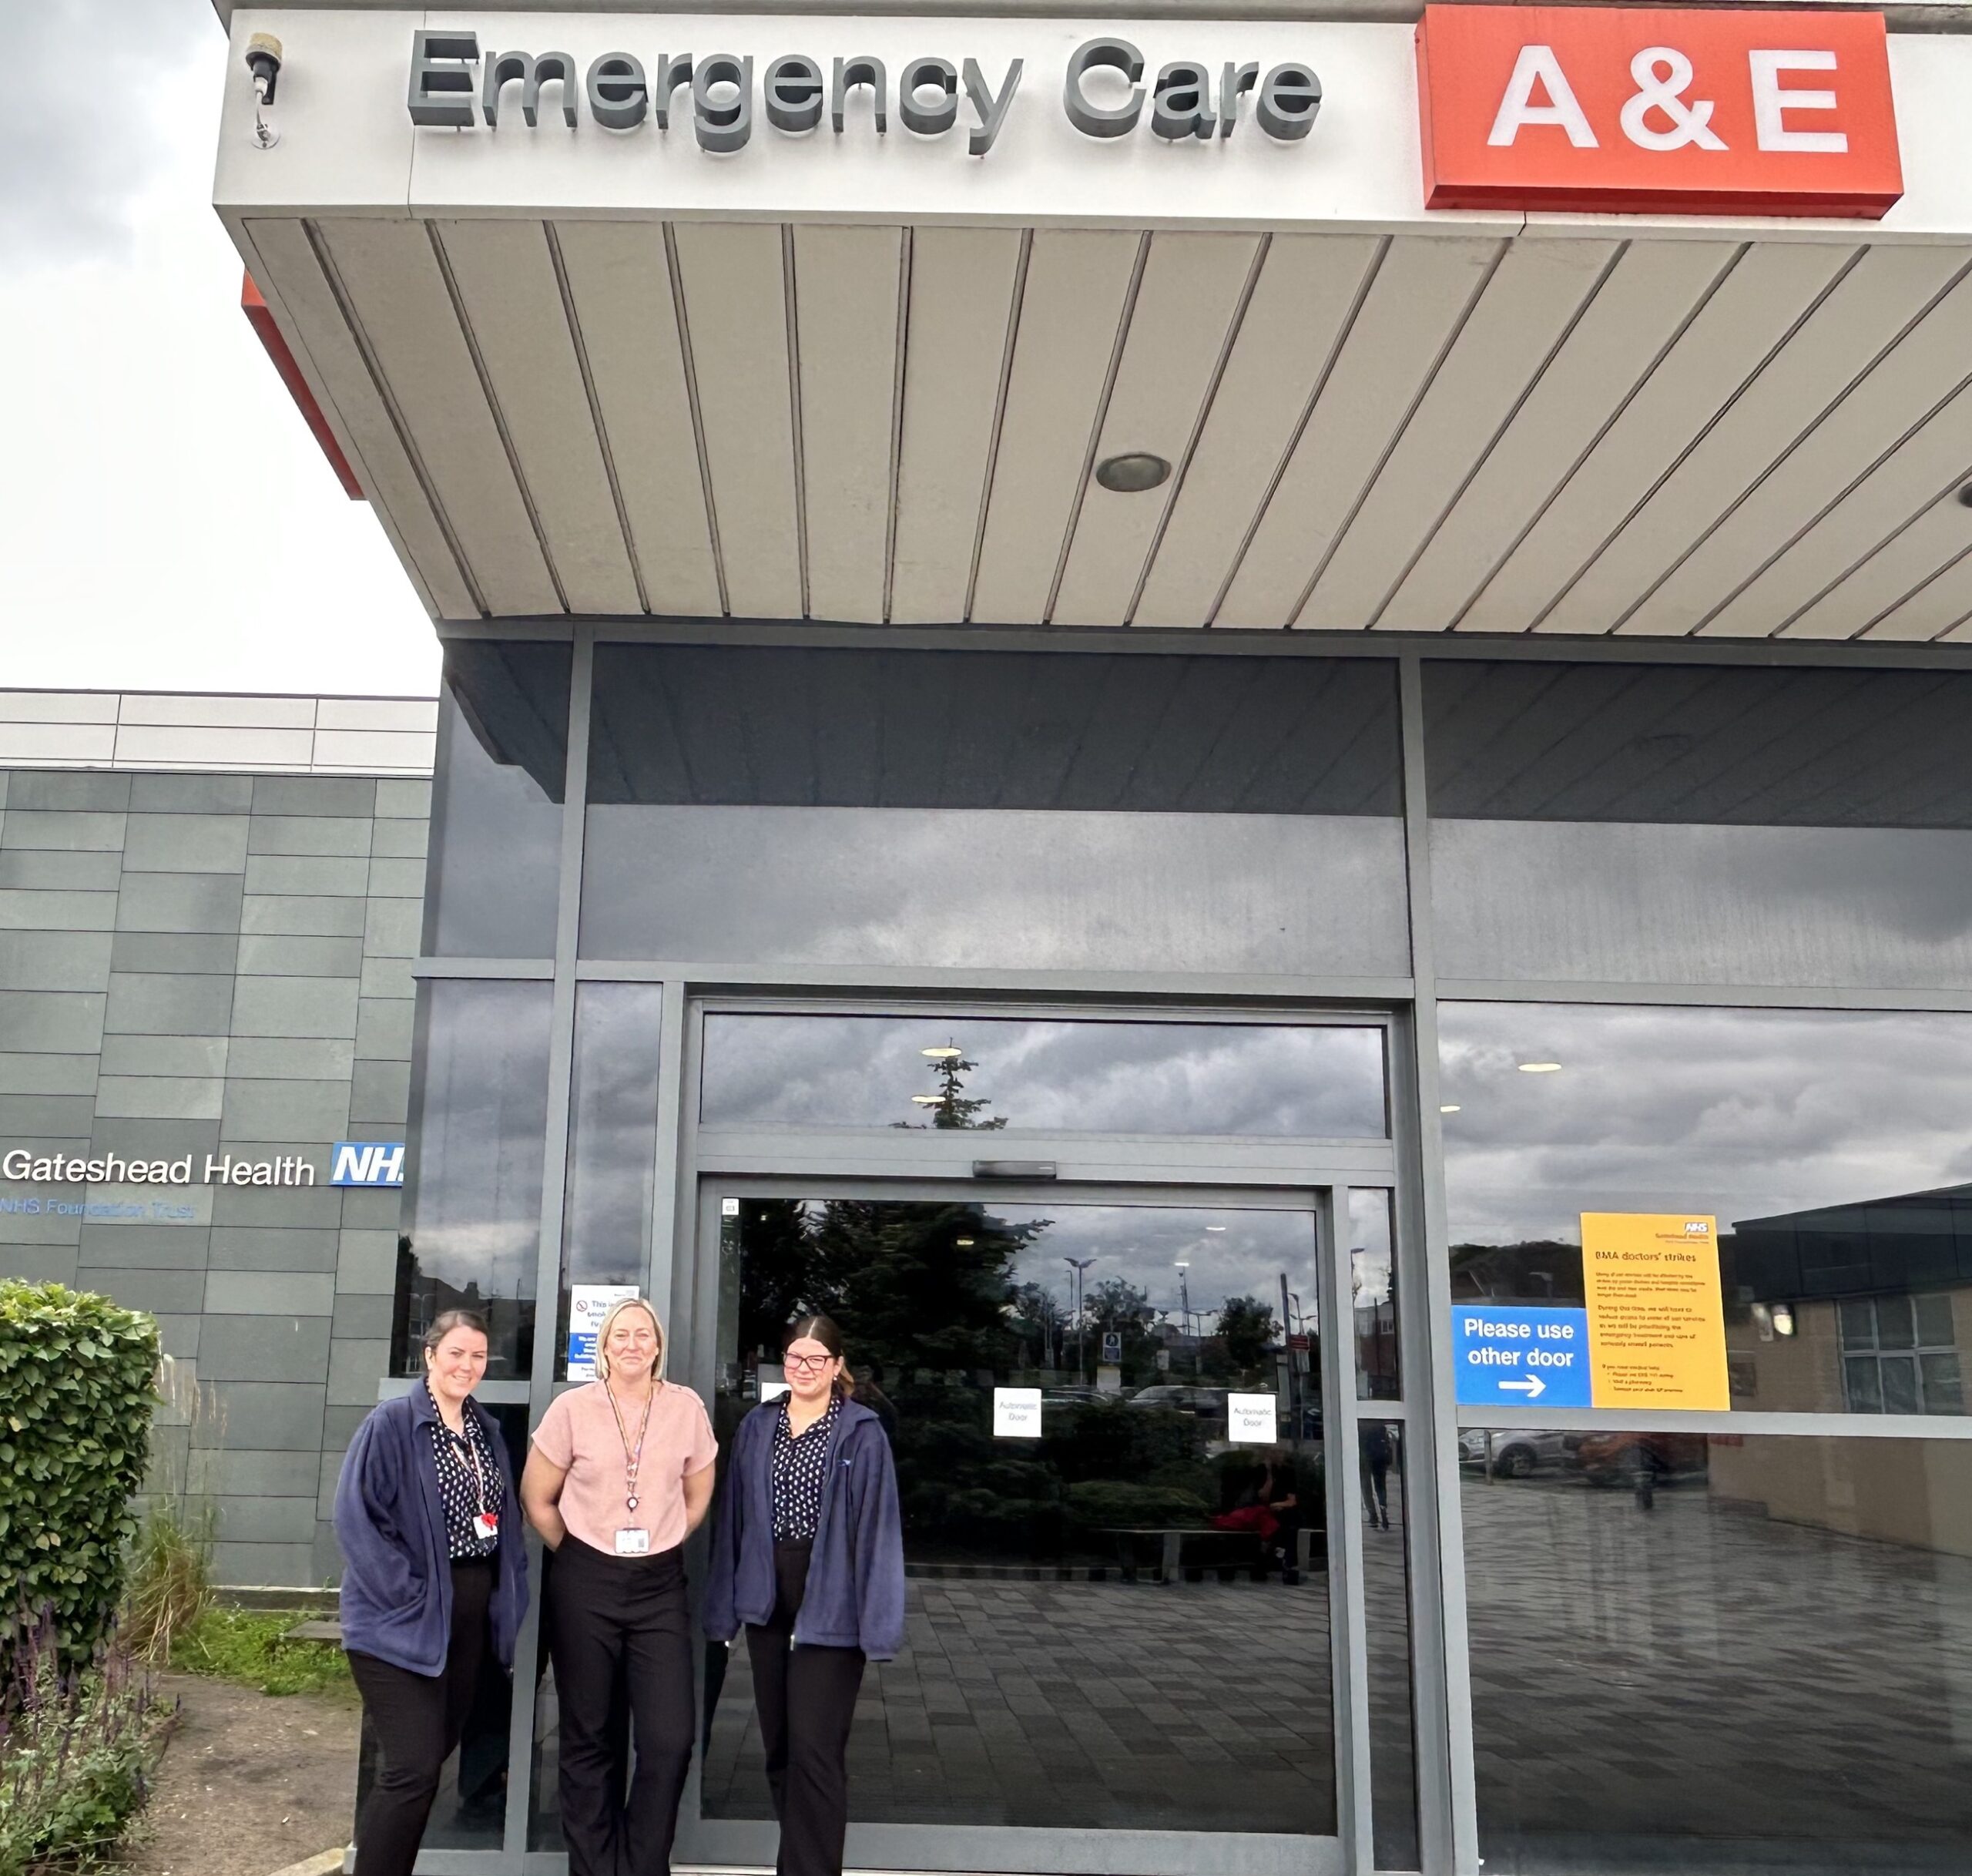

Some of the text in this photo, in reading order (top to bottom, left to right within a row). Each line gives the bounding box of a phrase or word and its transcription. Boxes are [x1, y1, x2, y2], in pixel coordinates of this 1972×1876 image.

[407, 29, 1323, 156] Emergency Care
[1487, 44, 1850, 153] A & E
[2, 1146, 405, 1186] Gateshead Health NH
[0, 1197, 39, 1215] NHS
[1685, 1223, 1708, 1233] NHS
[1464, 1318, 1574, 1339] Please use
[1467, 1347, 1574, 1367] other door
